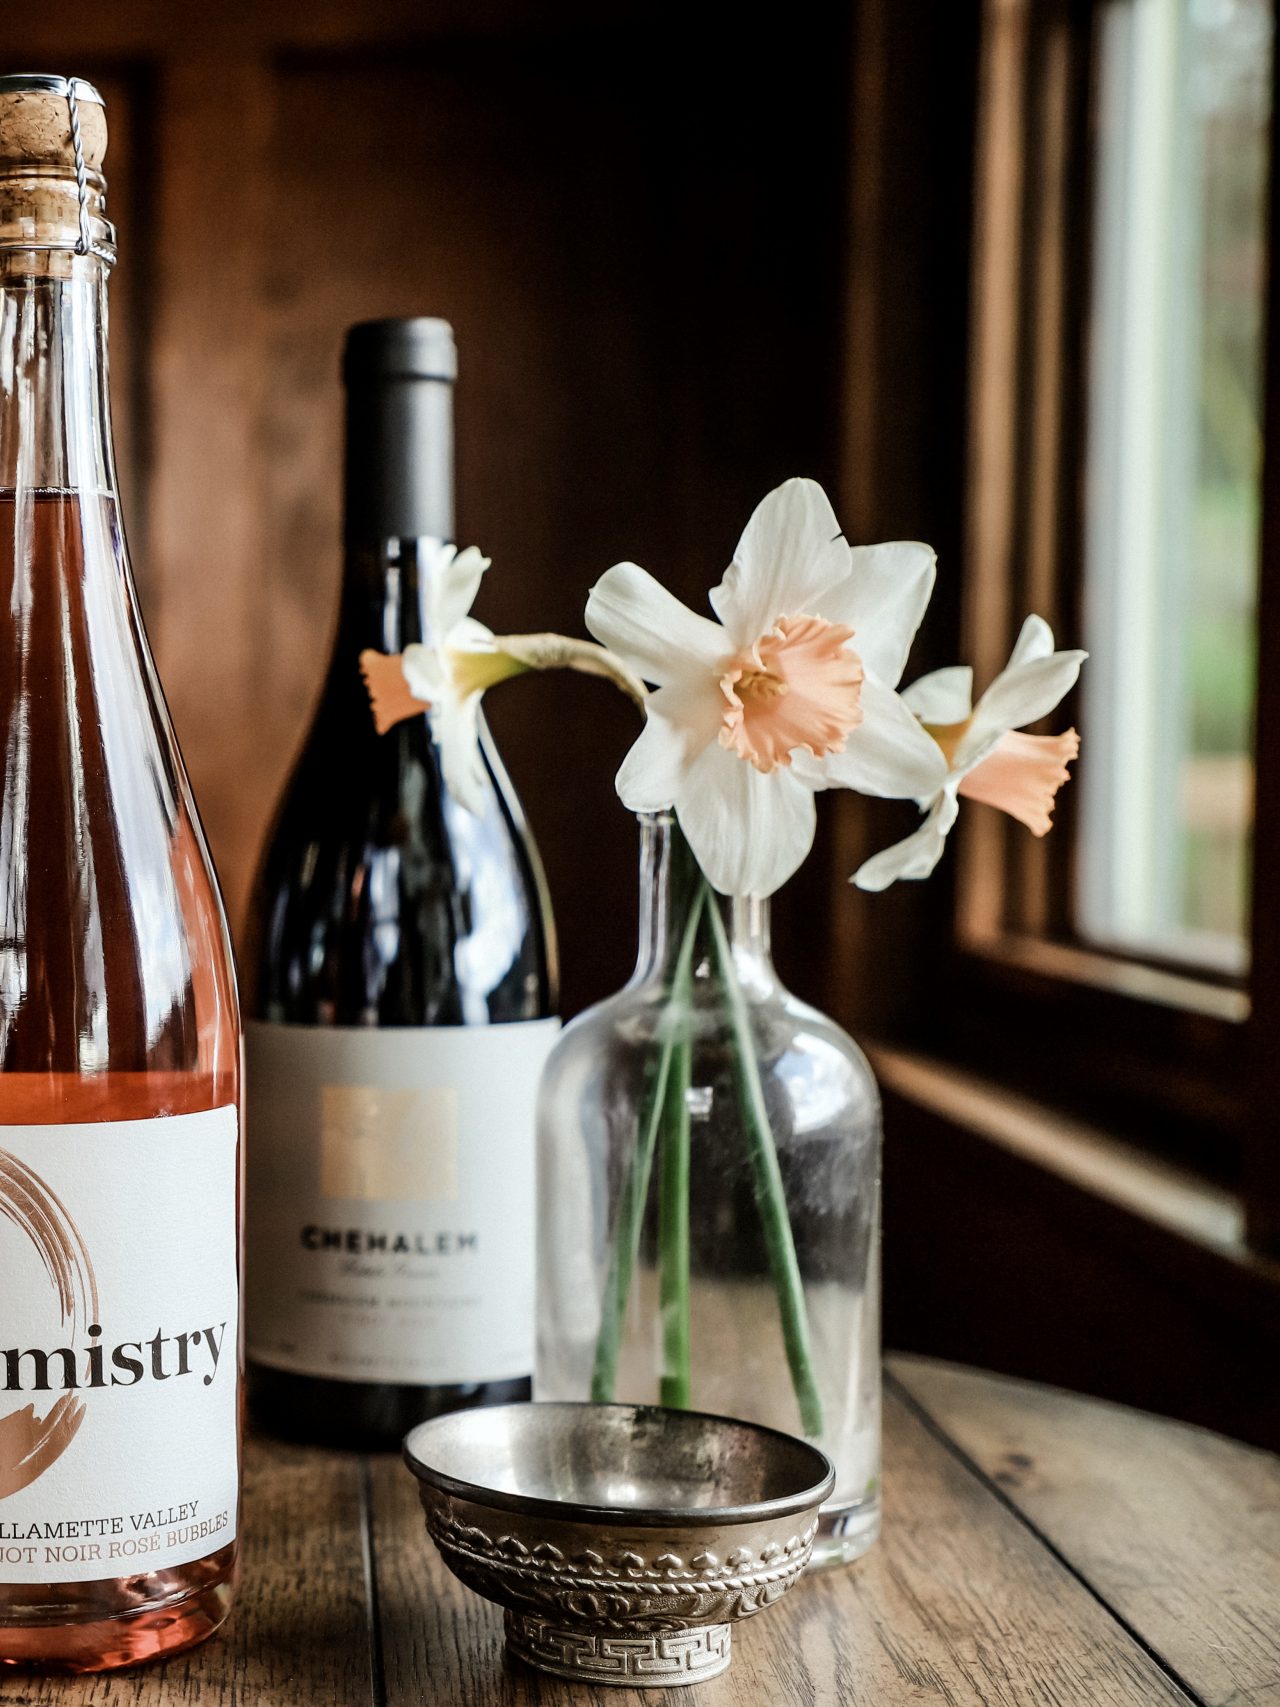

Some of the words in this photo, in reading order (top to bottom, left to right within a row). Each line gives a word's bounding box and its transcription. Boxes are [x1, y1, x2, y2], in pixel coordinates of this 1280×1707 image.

[301, 1225, 479, 1256] CHEHALEM
[130, 1500, 200, 1533] VALLEY
[44, 1544, 102, 1564] NOIR
[108, 1531, 161, 1560] ROSÉ
[166, 1509, 229, 1548] BUBBLES
